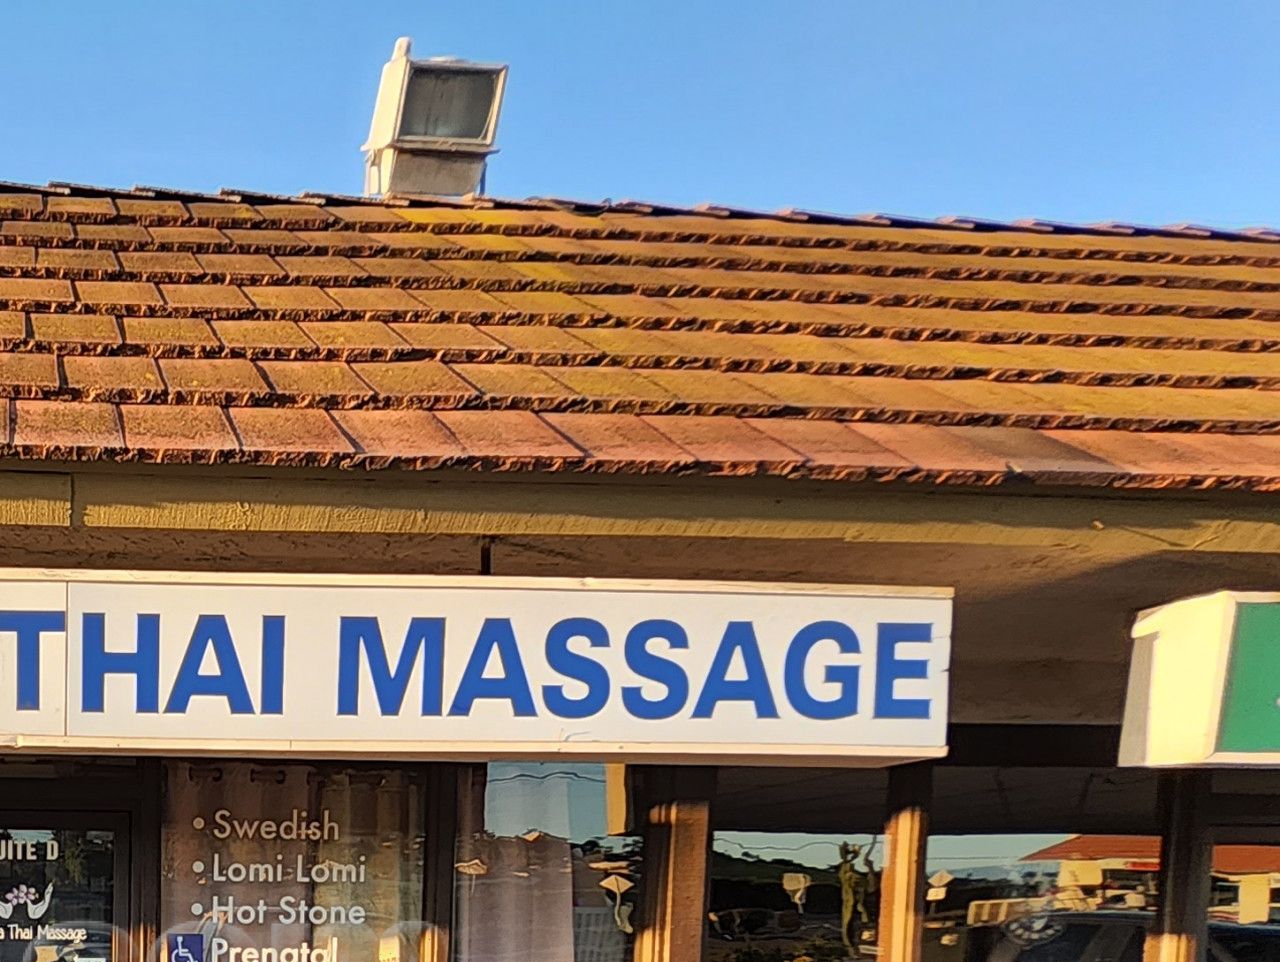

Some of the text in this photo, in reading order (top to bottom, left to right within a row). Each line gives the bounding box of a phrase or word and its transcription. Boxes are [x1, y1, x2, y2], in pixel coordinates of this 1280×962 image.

[337, 615, 936, 721] MASSAGE
[213, 809, 340, 841] Swedish
[46, 840, 59, 860] D
[212, 853, 367, 883] Lomi Lomi
[211, 895, 367, 925] Hot Stone
[8, 924, 33, 941] Thai
[37, 925, 87, 945] Massage
